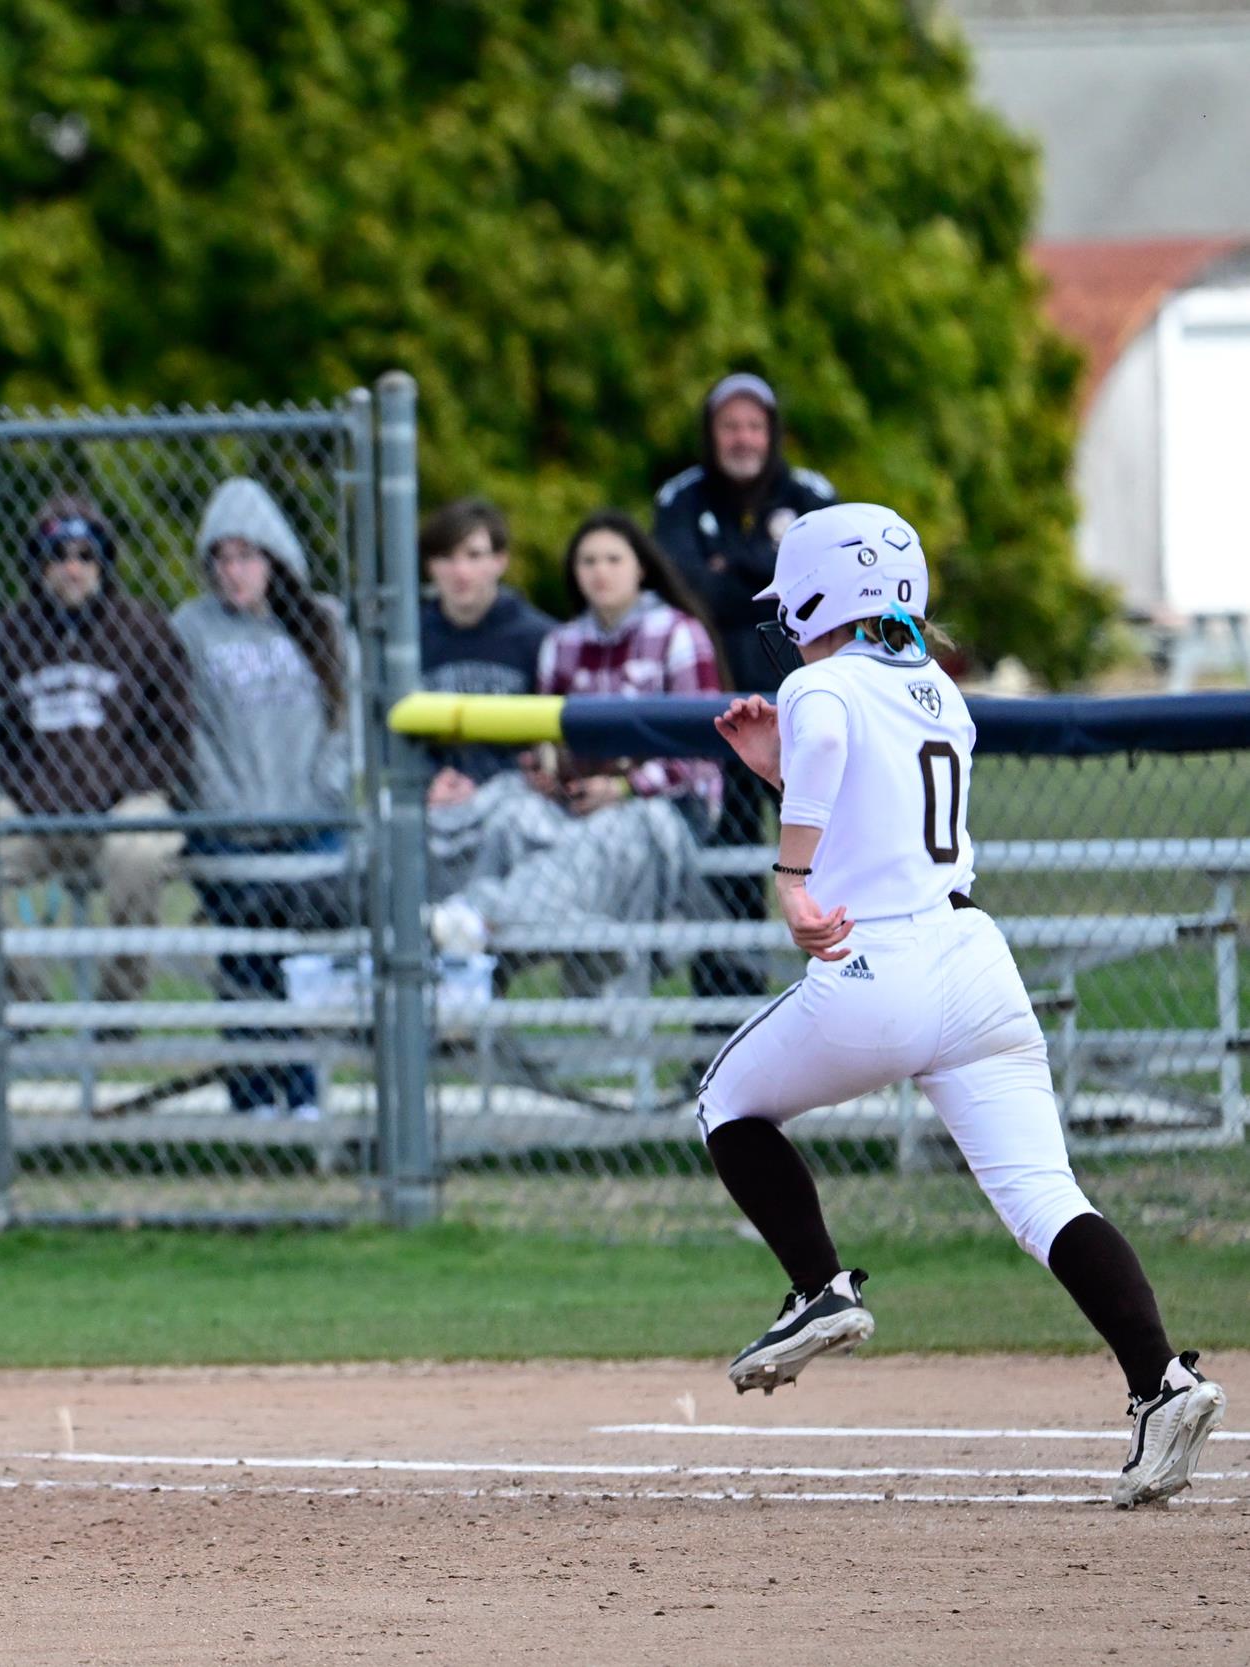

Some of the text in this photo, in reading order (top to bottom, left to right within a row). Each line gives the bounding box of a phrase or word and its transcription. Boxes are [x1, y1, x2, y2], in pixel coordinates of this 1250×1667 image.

[898, 579, 911, 602] 0
[919, 741, 960, 863] 0
[840, 968, 875, 980] adidas
